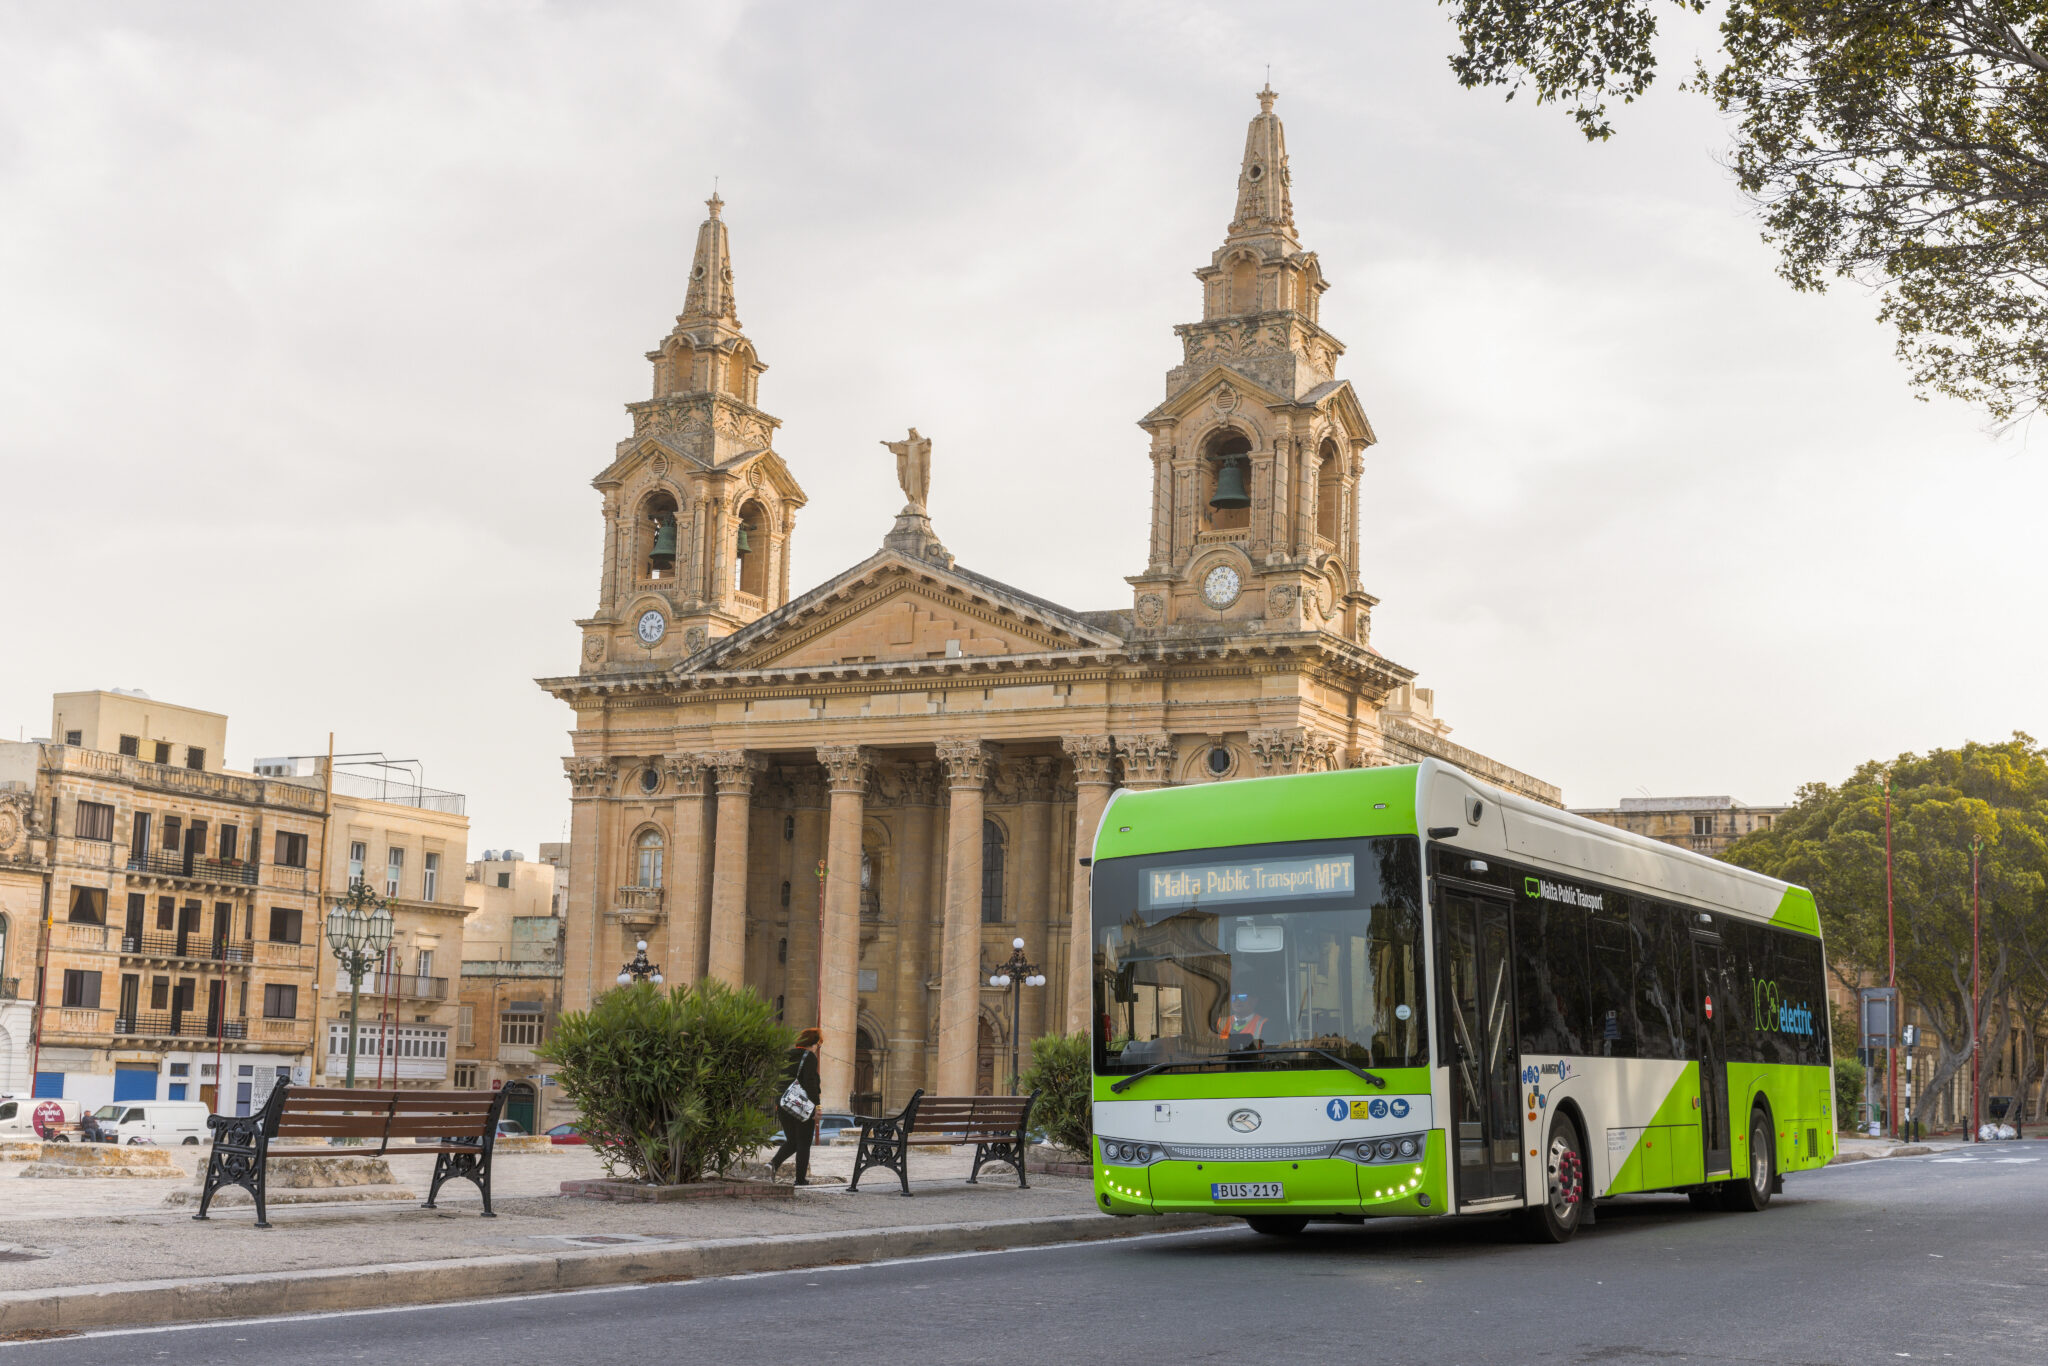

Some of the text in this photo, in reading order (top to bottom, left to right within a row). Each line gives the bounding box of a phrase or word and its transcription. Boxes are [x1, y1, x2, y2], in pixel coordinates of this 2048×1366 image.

[1154, 862, 1351, 898] Malta Public Transport MPT
[1540, 880, 1604, 913] Malta Public Transport
[1780, 999, 1813, 1036] electric
[1220, 1184, 1248, 1197] BUS
[1252, 1184, 1279, 1197] 219
